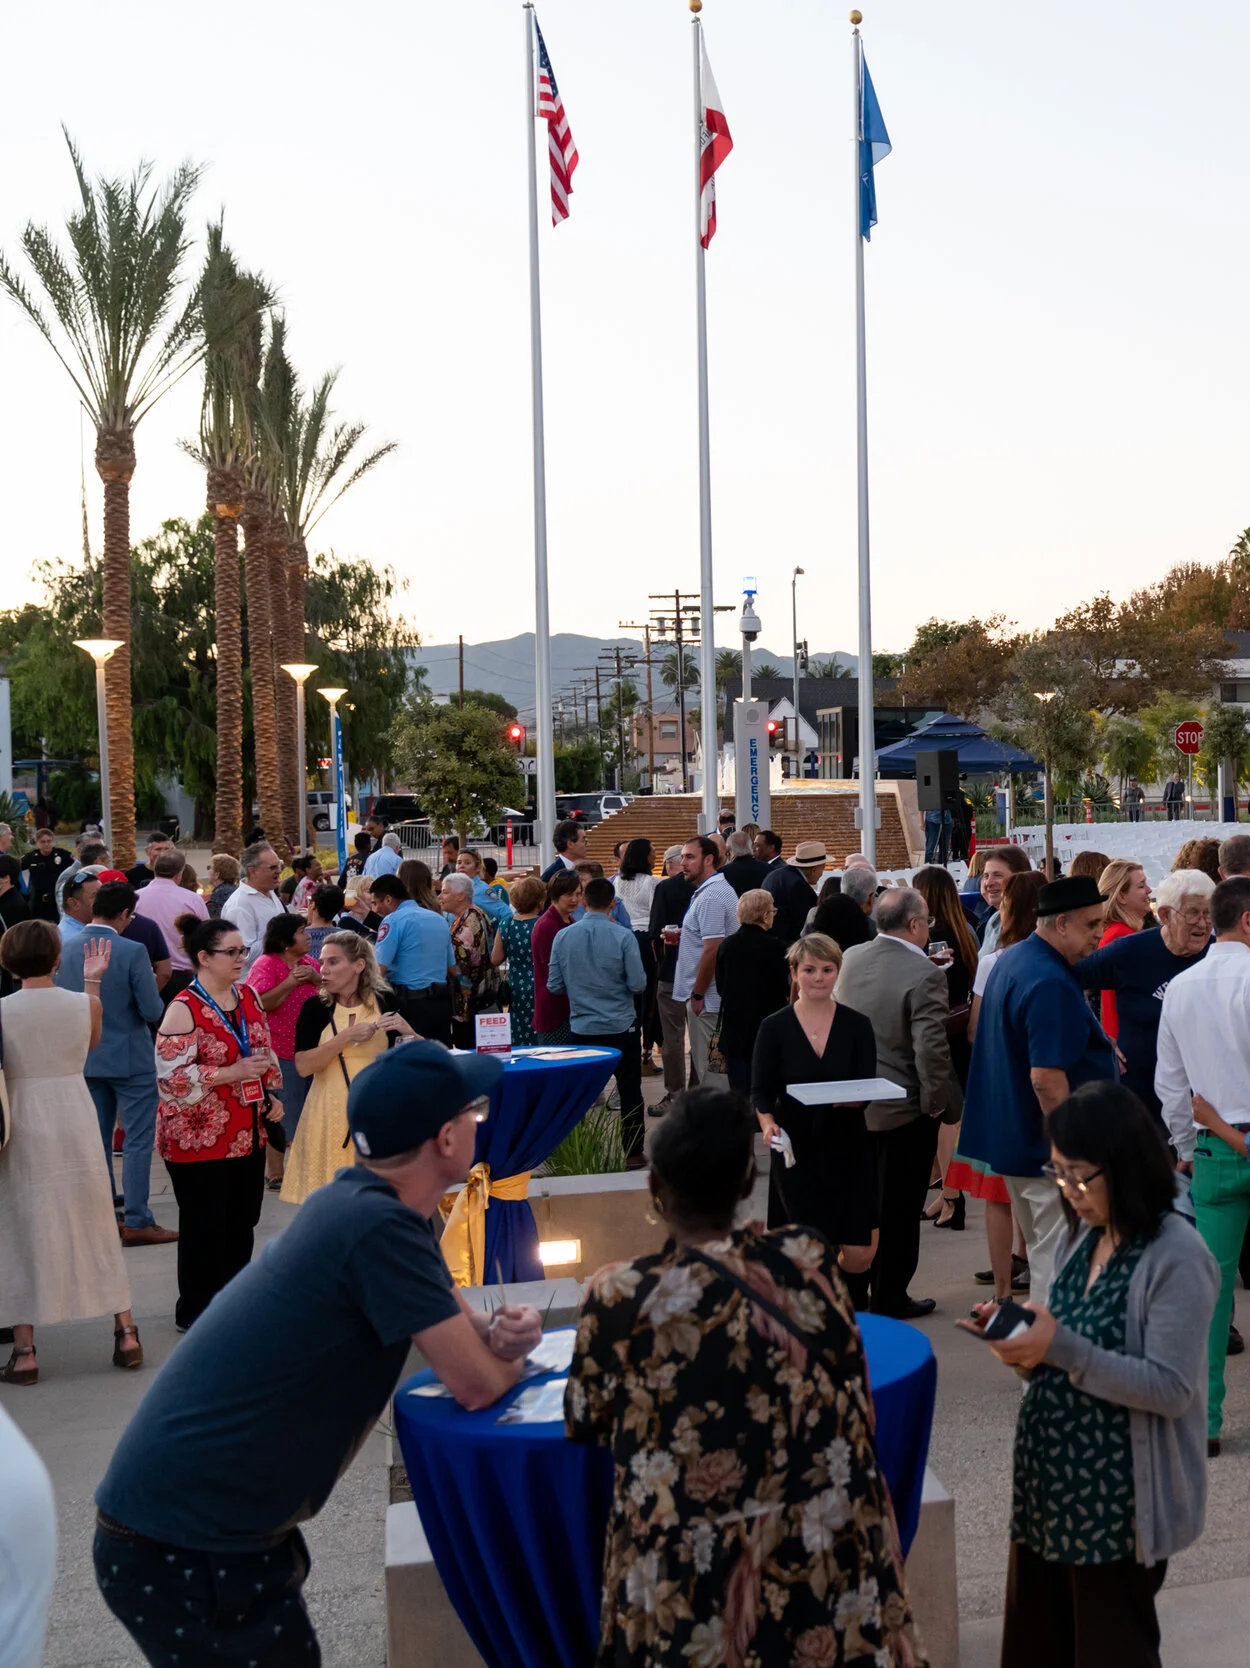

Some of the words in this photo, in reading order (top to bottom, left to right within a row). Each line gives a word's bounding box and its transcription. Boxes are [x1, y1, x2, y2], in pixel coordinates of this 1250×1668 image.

[1177, 731, 1205, 744] STOP
[750, 739, 759, 822] EMERGENCY
[480, 1017, 507, 1025] FEED
